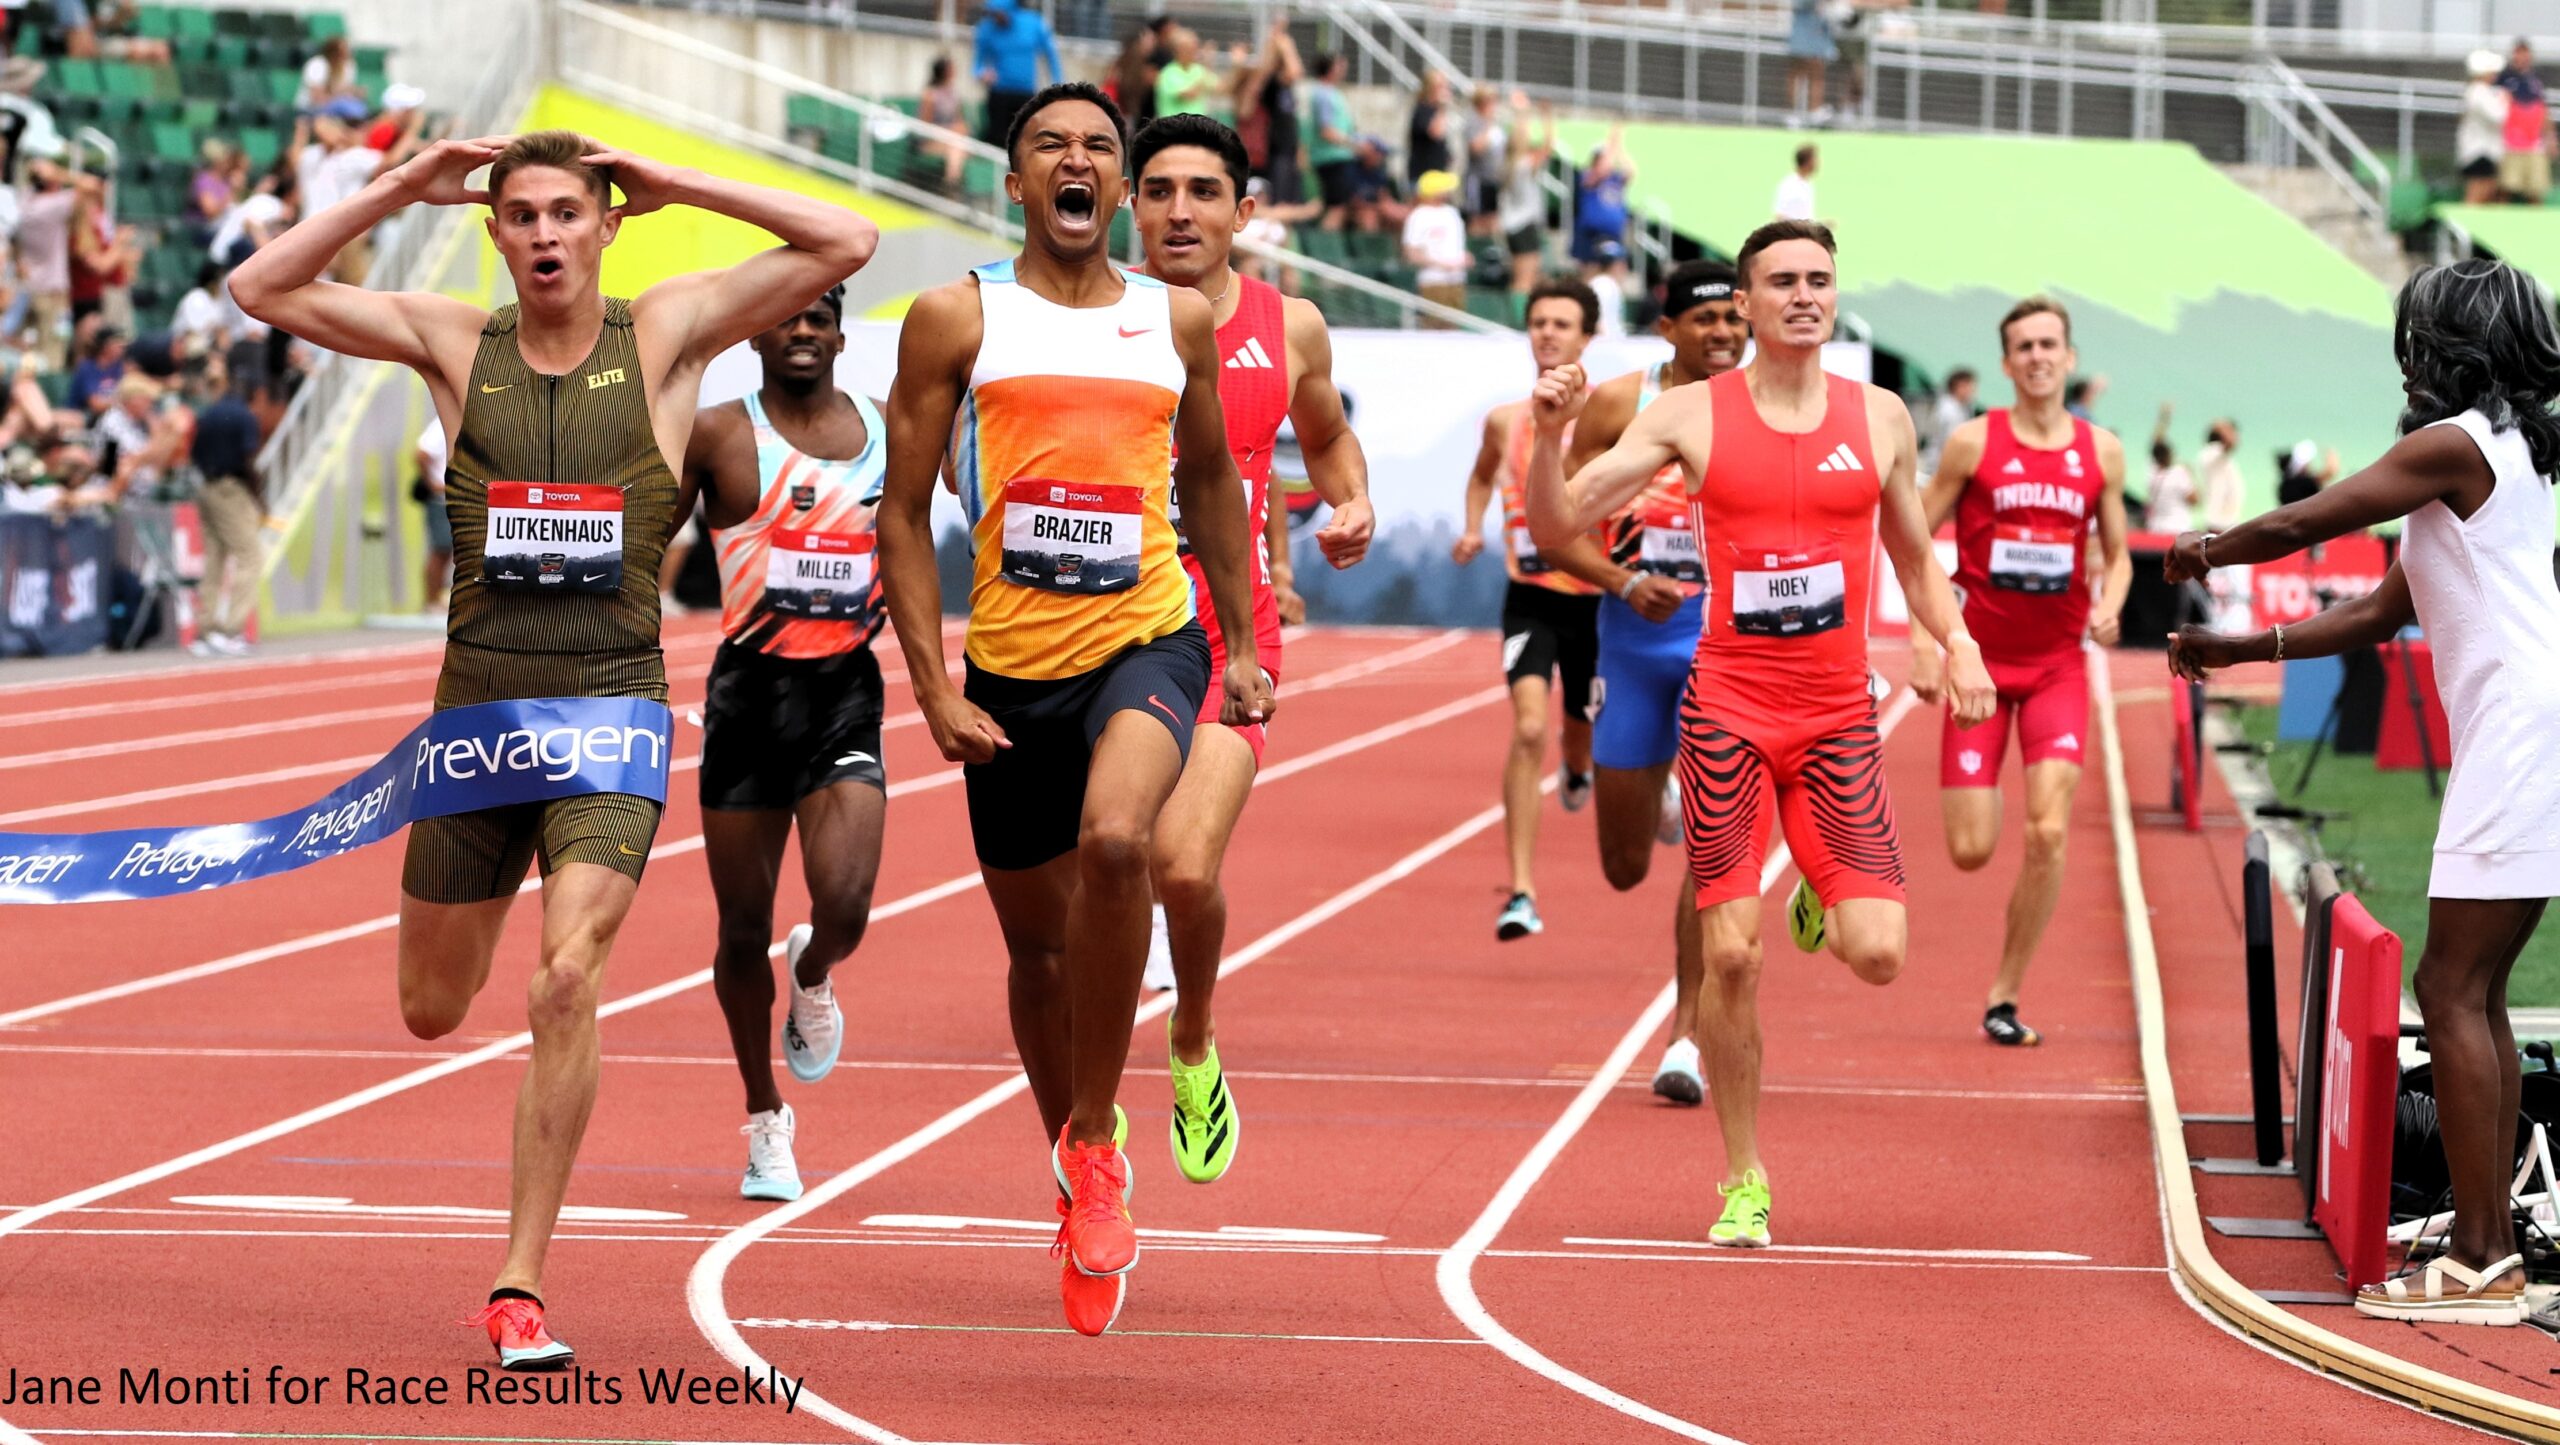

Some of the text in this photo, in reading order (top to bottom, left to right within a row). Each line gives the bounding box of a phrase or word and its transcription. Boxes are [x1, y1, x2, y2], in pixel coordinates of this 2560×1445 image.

[587, 368, 626, 390] ELITE
[545, 492, 581, 502] TOYOTA
[1067, 492, 1103, 503] TOYOTA
[1992, 481, 2086, 519] INDIANA
[496, 516, 614, 543] LUTKENHAUS
[1033, 514, 1113, 545] BRAZIER
[1665, 532, 1695, 552] HAR
[796, 559, 852, 580] MILLER
[1768, 575, 1809, 598] HOEY
